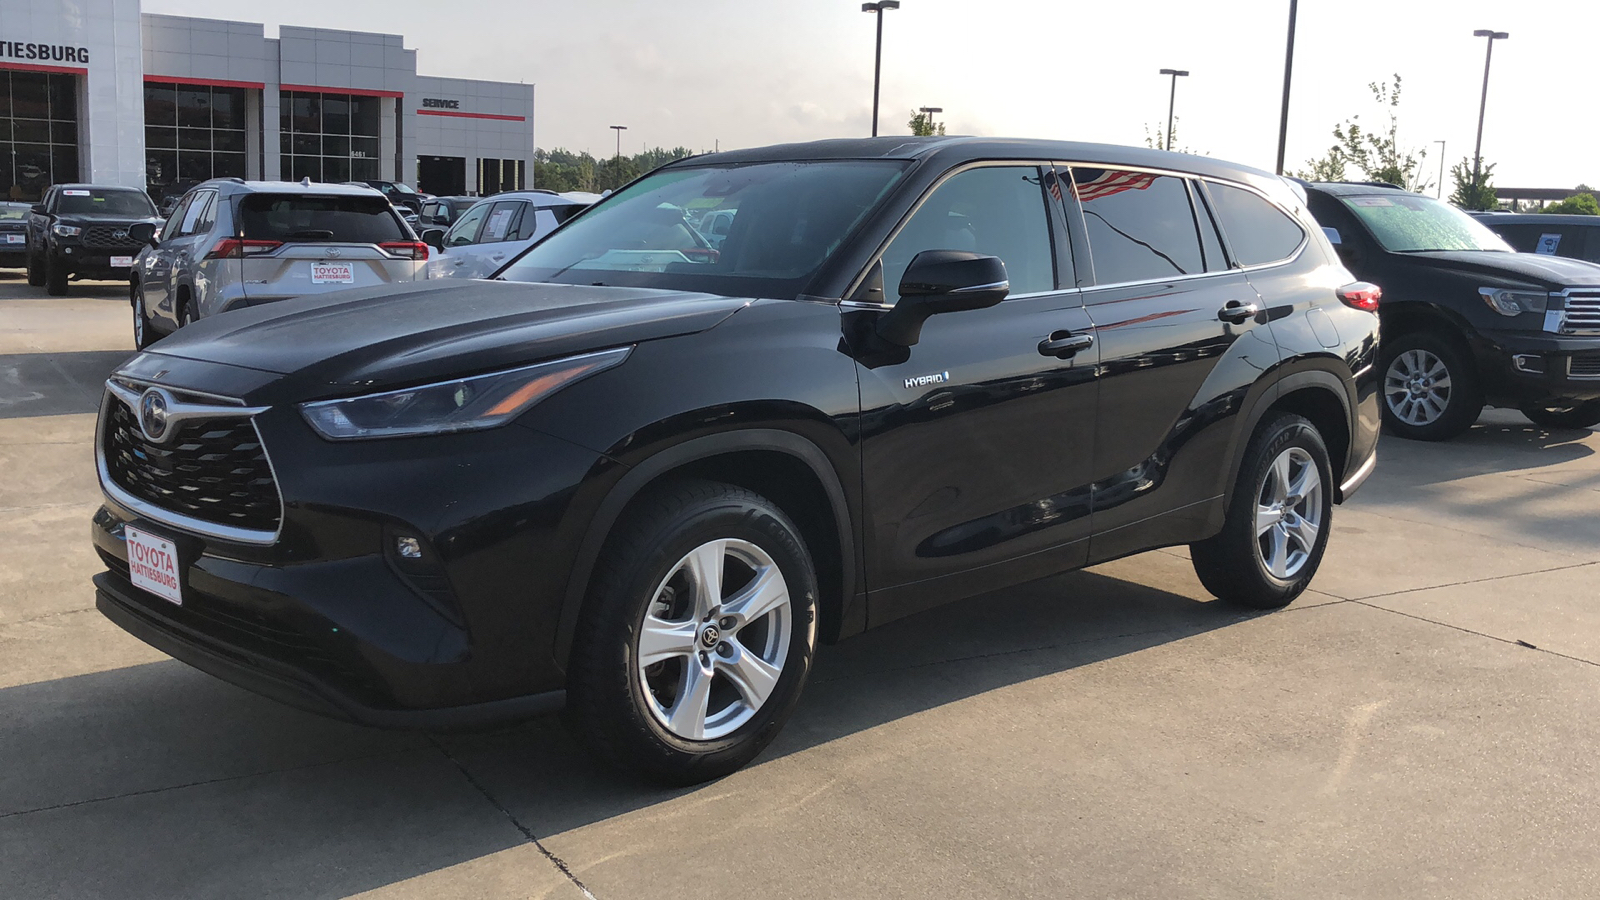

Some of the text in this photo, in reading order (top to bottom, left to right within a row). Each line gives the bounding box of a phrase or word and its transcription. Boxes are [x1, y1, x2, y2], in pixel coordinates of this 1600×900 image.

[422, 98, 459, 109] SERVICE
[903, 373, 943, 389] HYBRID
[128, 539, 175, 574] TOYOTA
[131, 560, 177, 590] HATTIESBURG
